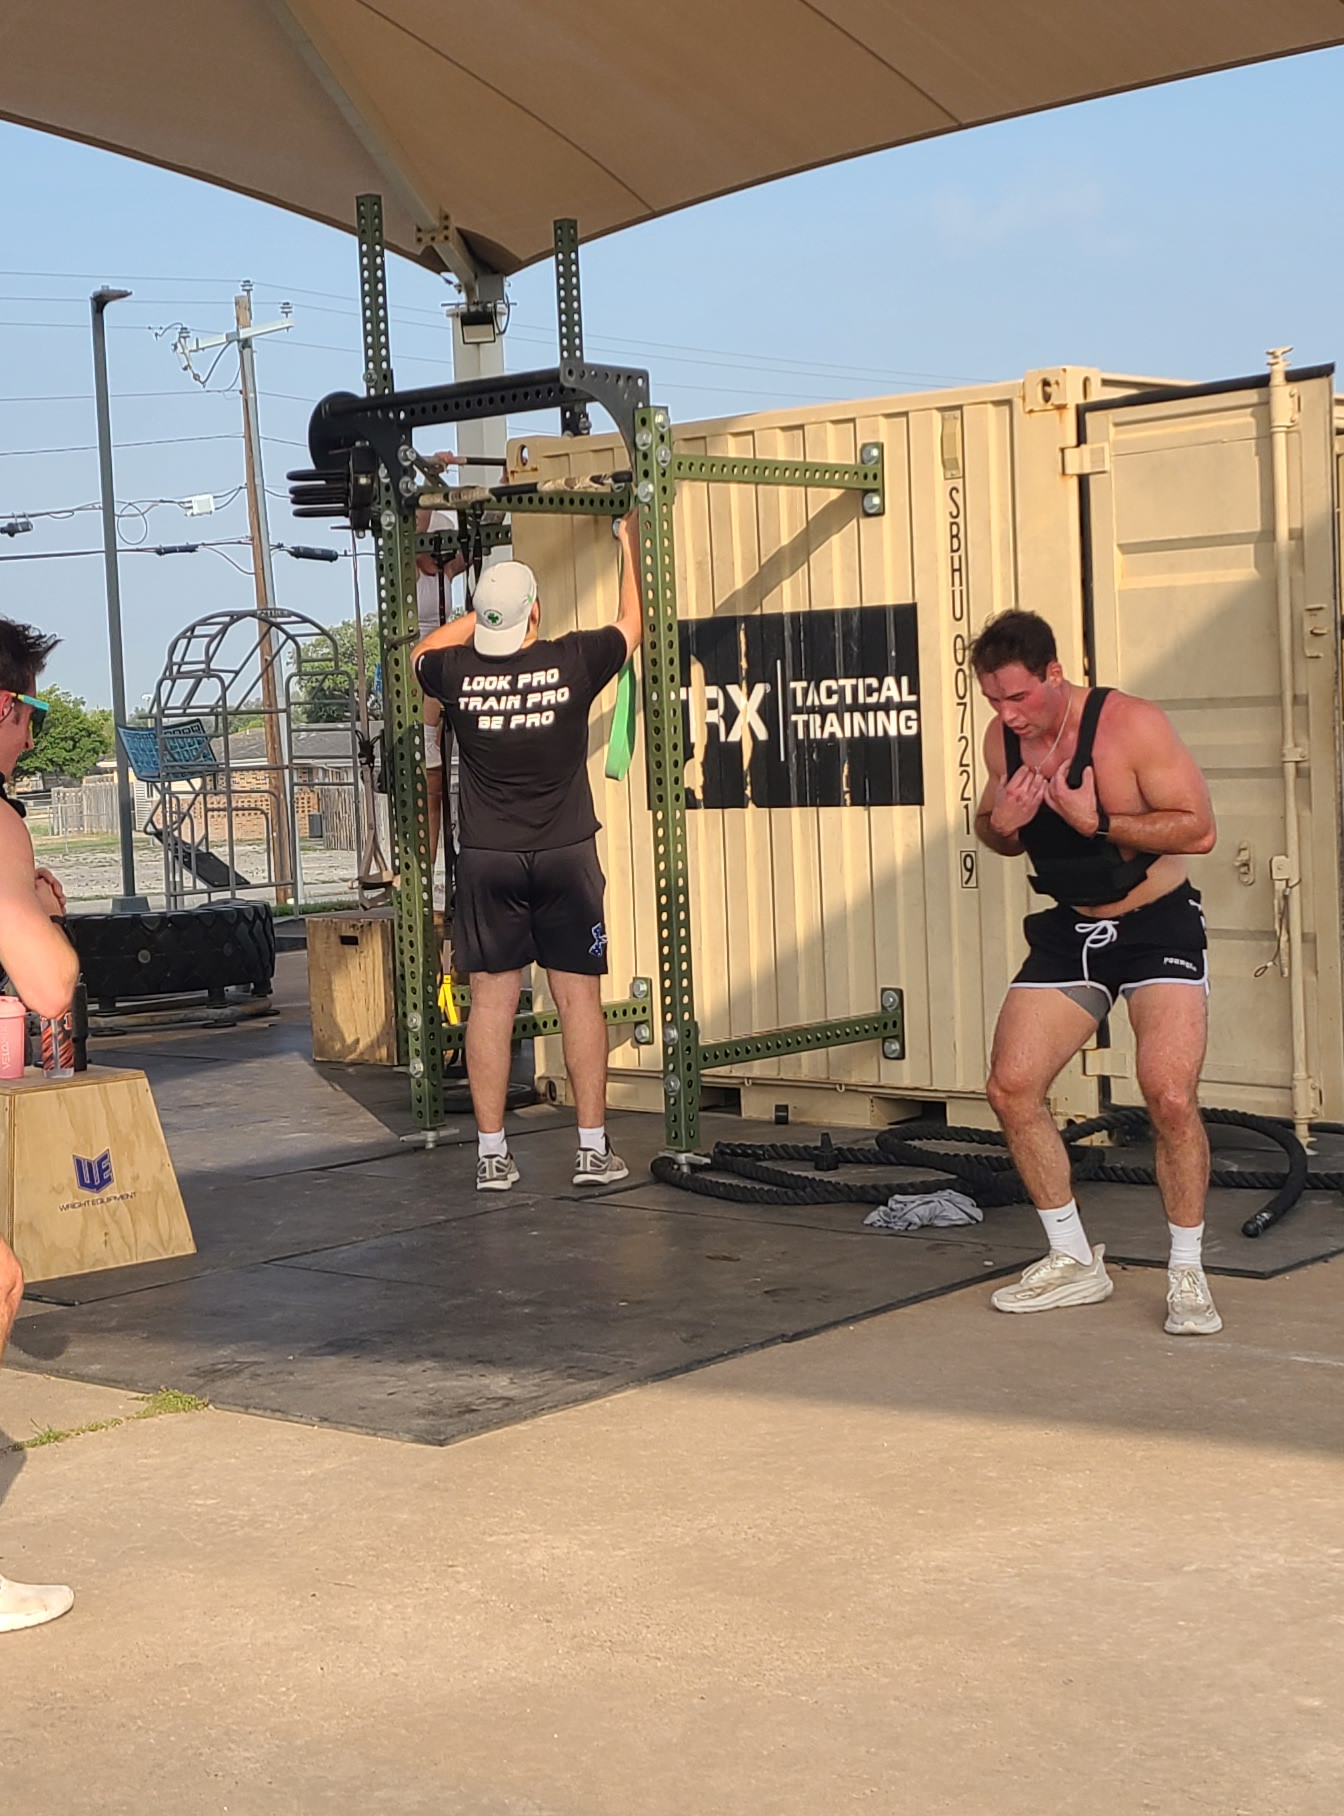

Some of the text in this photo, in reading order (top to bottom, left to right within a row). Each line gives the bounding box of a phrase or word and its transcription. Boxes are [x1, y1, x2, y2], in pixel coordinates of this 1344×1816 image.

[462, 668, 559, 691] LOOK PRO
[790, 676, 918, 706] TACTICAL
[948, 486, 976, 887] SBHU 007221 9
[458, 686, 570, 711] TRAIN PRO
[680, 683, 769, 743] RX
[477, 710, 555, 729] BE PRO
[791, 709, 918, 739] TRAINING
